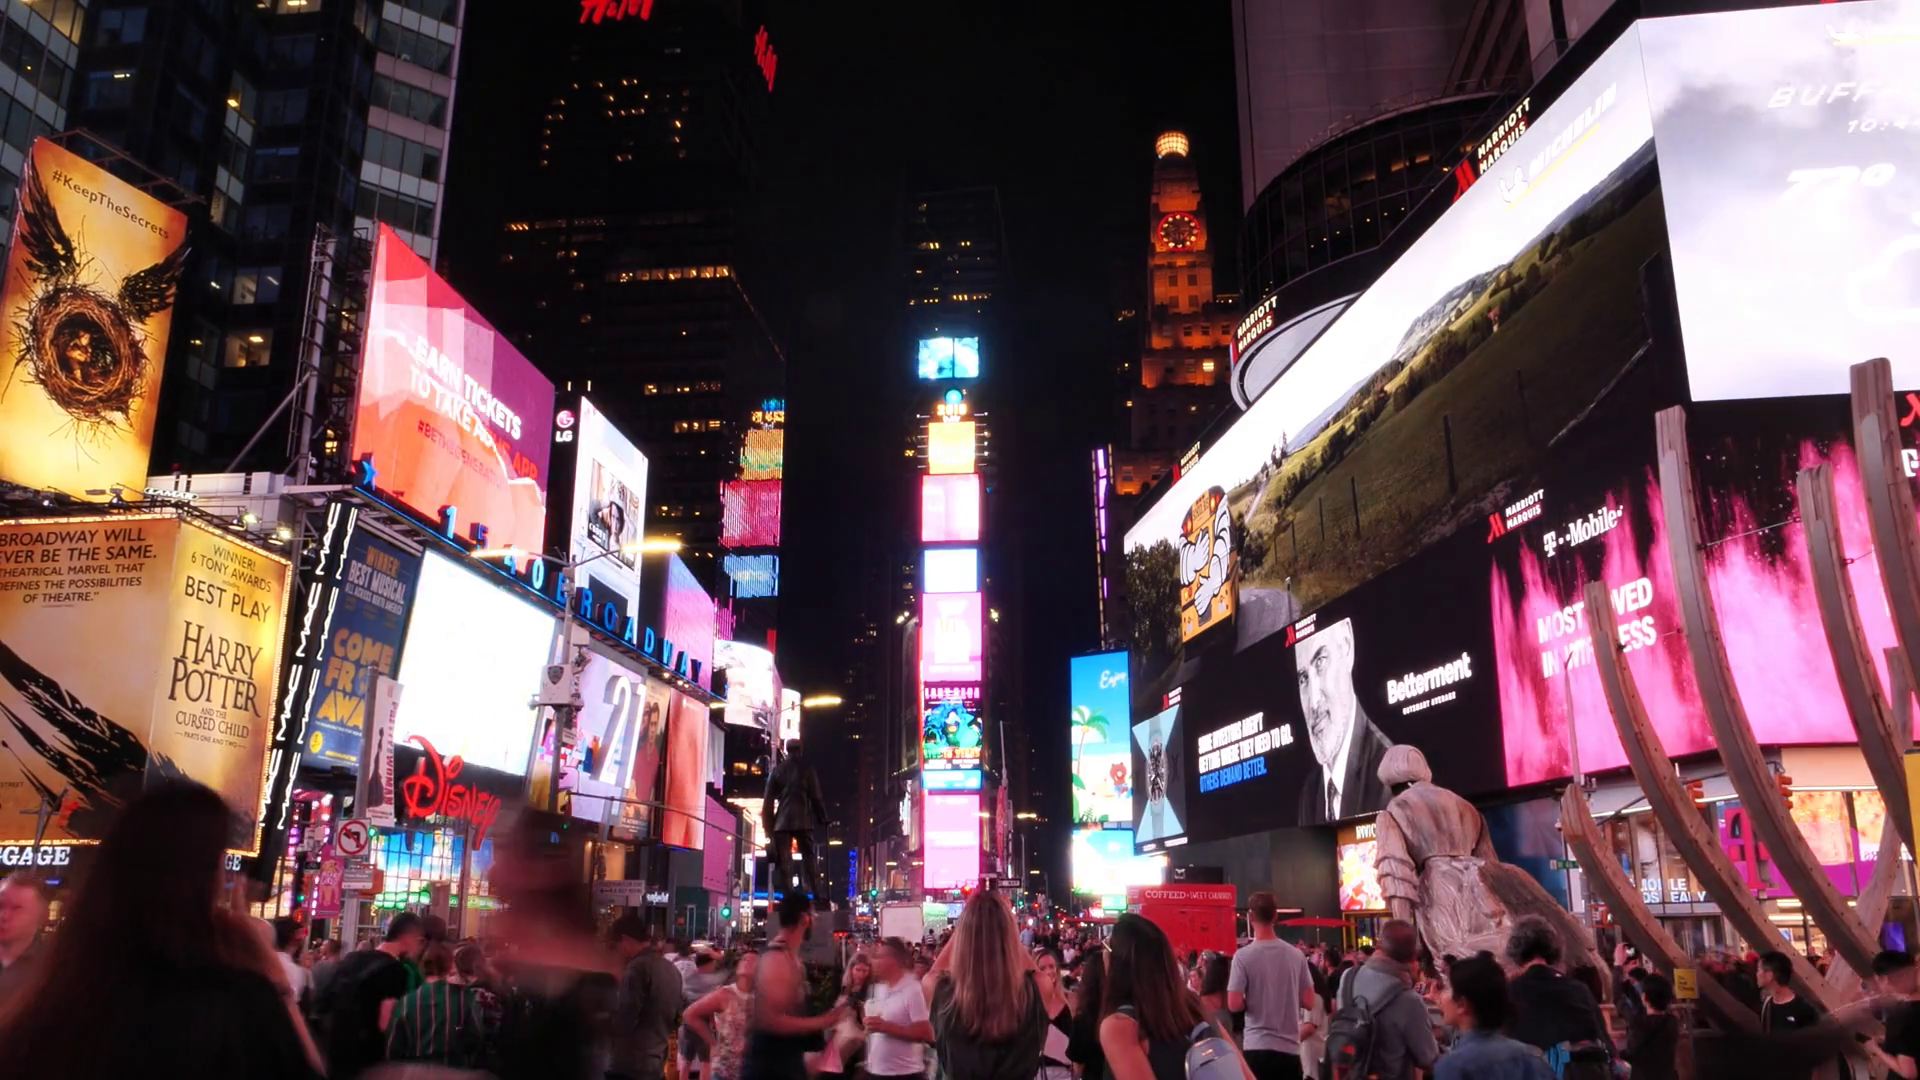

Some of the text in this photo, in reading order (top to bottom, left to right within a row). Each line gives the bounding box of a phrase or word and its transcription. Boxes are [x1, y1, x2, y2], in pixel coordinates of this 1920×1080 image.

[1478, 97, 1530, 159] MARRIOTT
[1479, 121, 1526, 175] MARQUIS
[52, 170, 169, 239] #KeepTheSecrets
[1237, 295, 1278, 339] MARRIOTT
[1238, 315, 1272, 353] MARQUIS
[410, 364, 471, 431] TO TAKE
[464, 374, 522, 440] TICKETS
[556, 430, 573, 442] LG
[1505, 489, 1544, 517] MARRIOTT
[1506, 504, 1541, 529] MARQUIS
[0, 527, 147, 547] BROADWAY WILL
[40, 549, 61, 563] BE
[67, 547, 101, 562] THE
[105, 544, 157, 560] SAME.
[213, 544, 256, 571] WINNER!
[0, 562, 145, 578] THEATRICAL MARVEL THAT
[44, 579, 65, 589] THE
[68, 576, 142, 588] POSSIBILITIES
[191, 551, 272, 592] 6 TONY AWARDS
[348, 560, 406, 604] BEST MUSICAL
[22, 593, 39, 604] OF
[185, 575, 271, 623] BEST PLAY
[1537, 601, 1584, 644] MOST
[180, 620, 263, 681] HARRY
[333, 627, 394, 674] COME
[1541, 649, 1560, 679] IN
[168, 657, 262, 718] POTTER
[1387, 652, 1472, 704] Betterment
[175, 711, 249, 739] CURSED CHILD
[200, 707, 227, 720] AND THE
[316, 689, 366, 730] AWA
[600, 675, 647, 790] 21
[0, 846, 71, 866] GAGE
[1145, 890, 1186, 899] COFFEED
